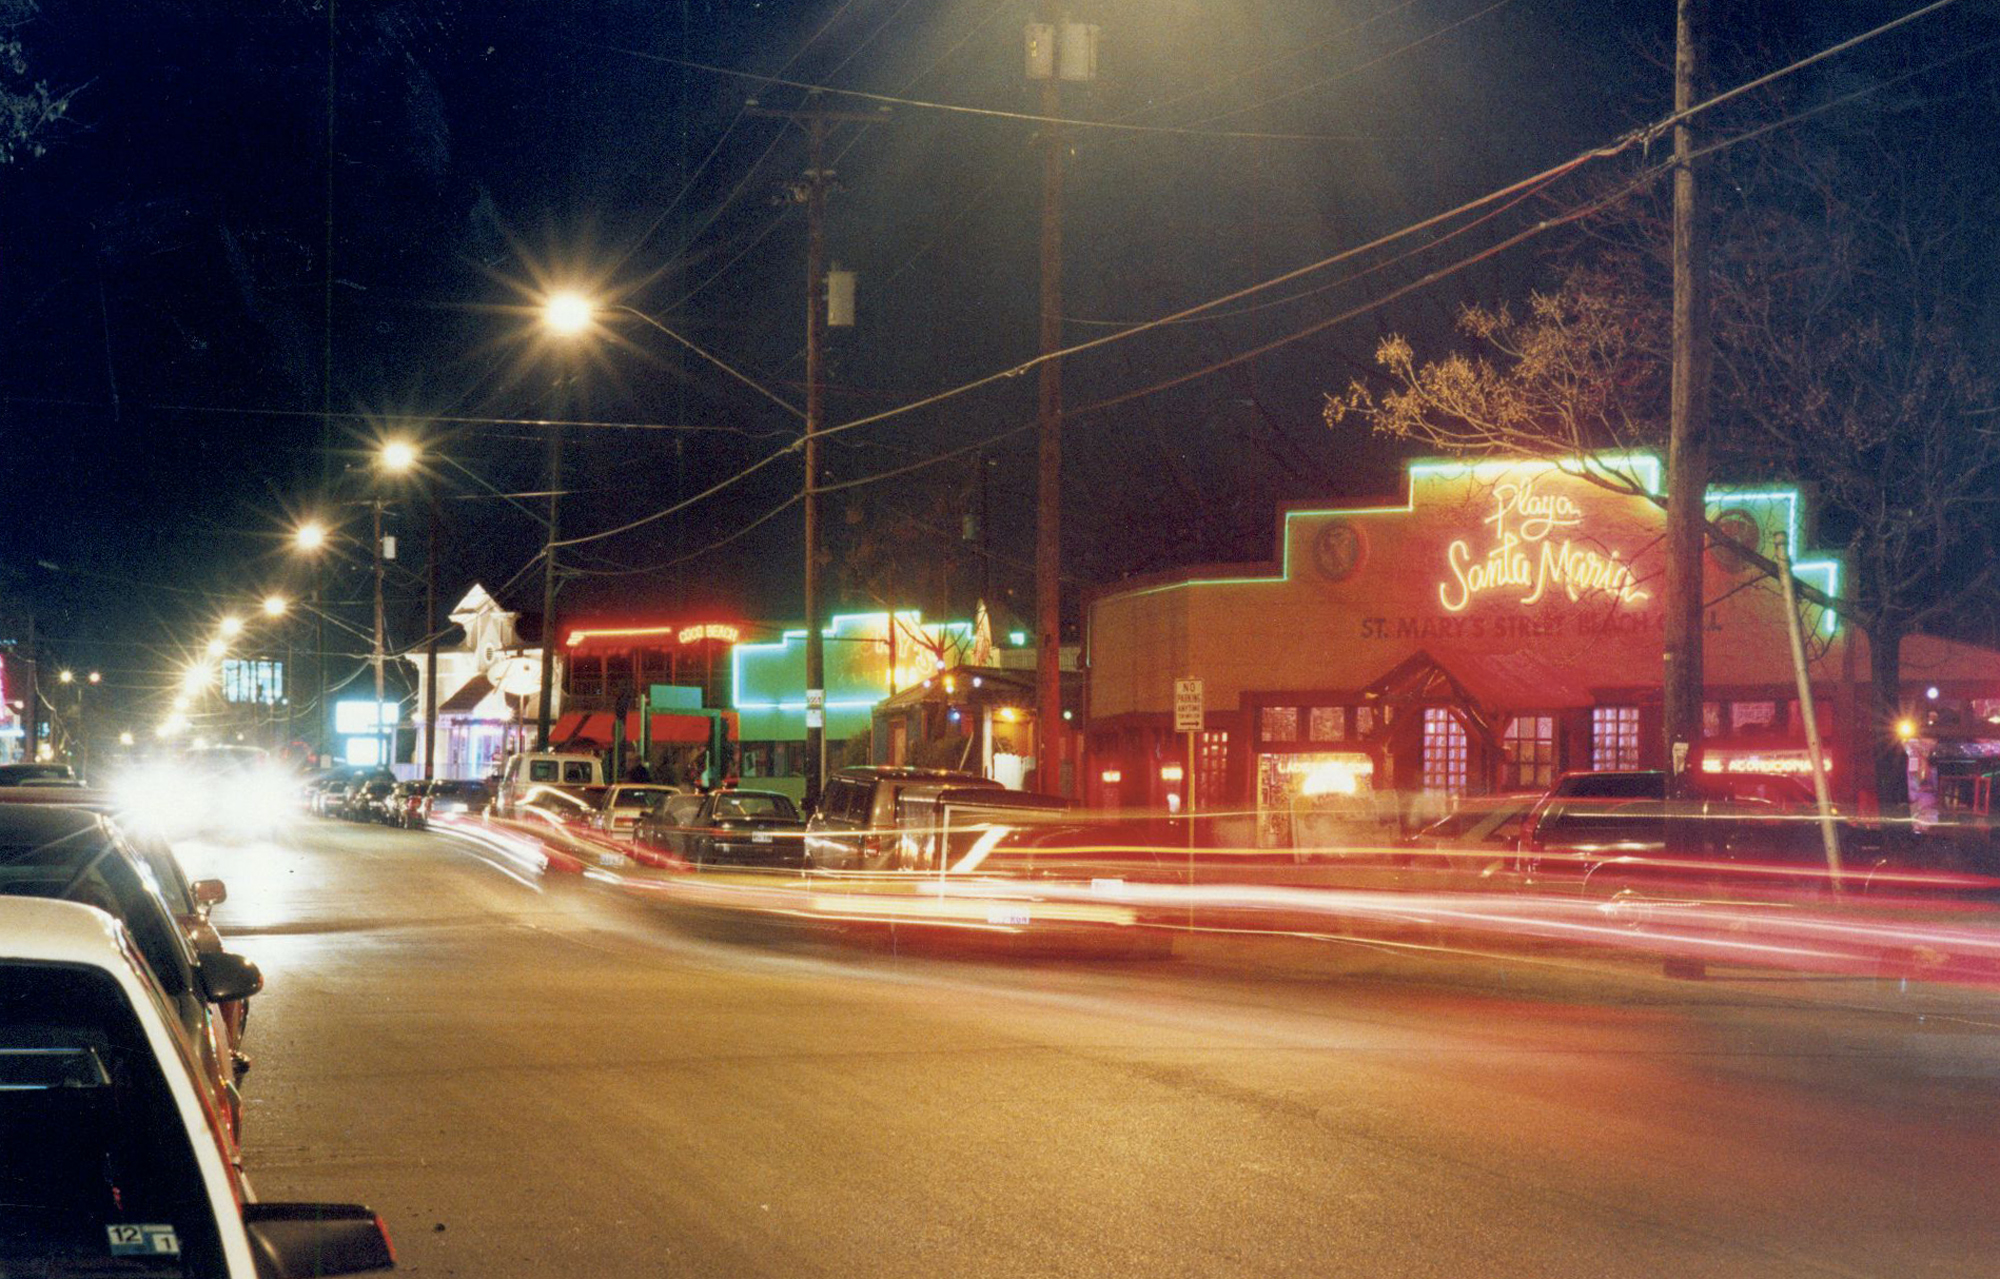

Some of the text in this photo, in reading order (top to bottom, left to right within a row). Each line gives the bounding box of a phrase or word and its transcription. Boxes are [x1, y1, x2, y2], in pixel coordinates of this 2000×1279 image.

[1484, 477, 1583, 542] Playa
[1439, 531, 1649, 611] Santa Maria
[1361, 617, 1389, 639] ST.
[1578, 611, 1649, 635] BEACH
[1183, 682, 1196, 693] NO
[112, 1227, 141, 1243] 12
[161, 1236, 171, 1250] 1
